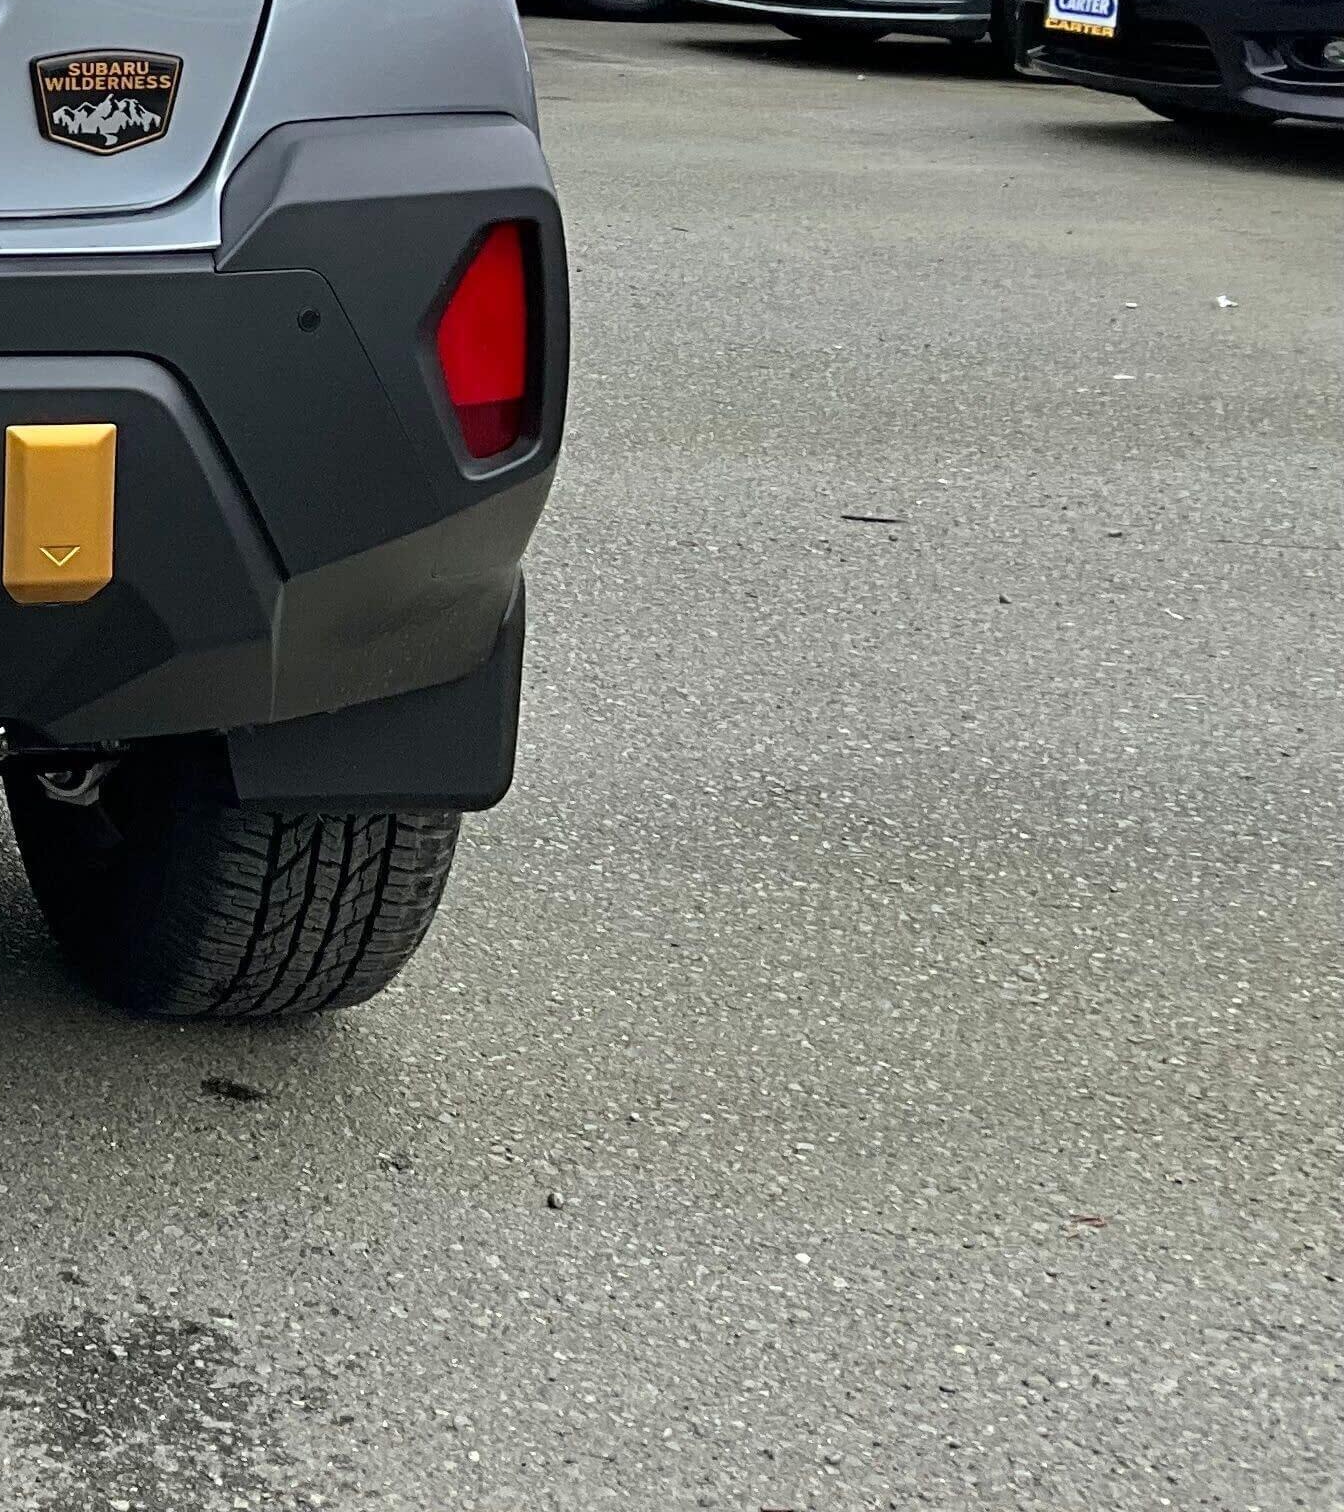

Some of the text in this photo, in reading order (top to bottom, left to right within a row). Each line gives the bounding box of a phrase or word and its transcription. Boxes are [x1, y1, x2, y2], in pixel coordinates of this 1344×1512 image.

[1045, 18, 1115, 37] CARTER
[68, 61, 149, 76] SUBARU
[44, 75, 172, 92] WILDERNESS
